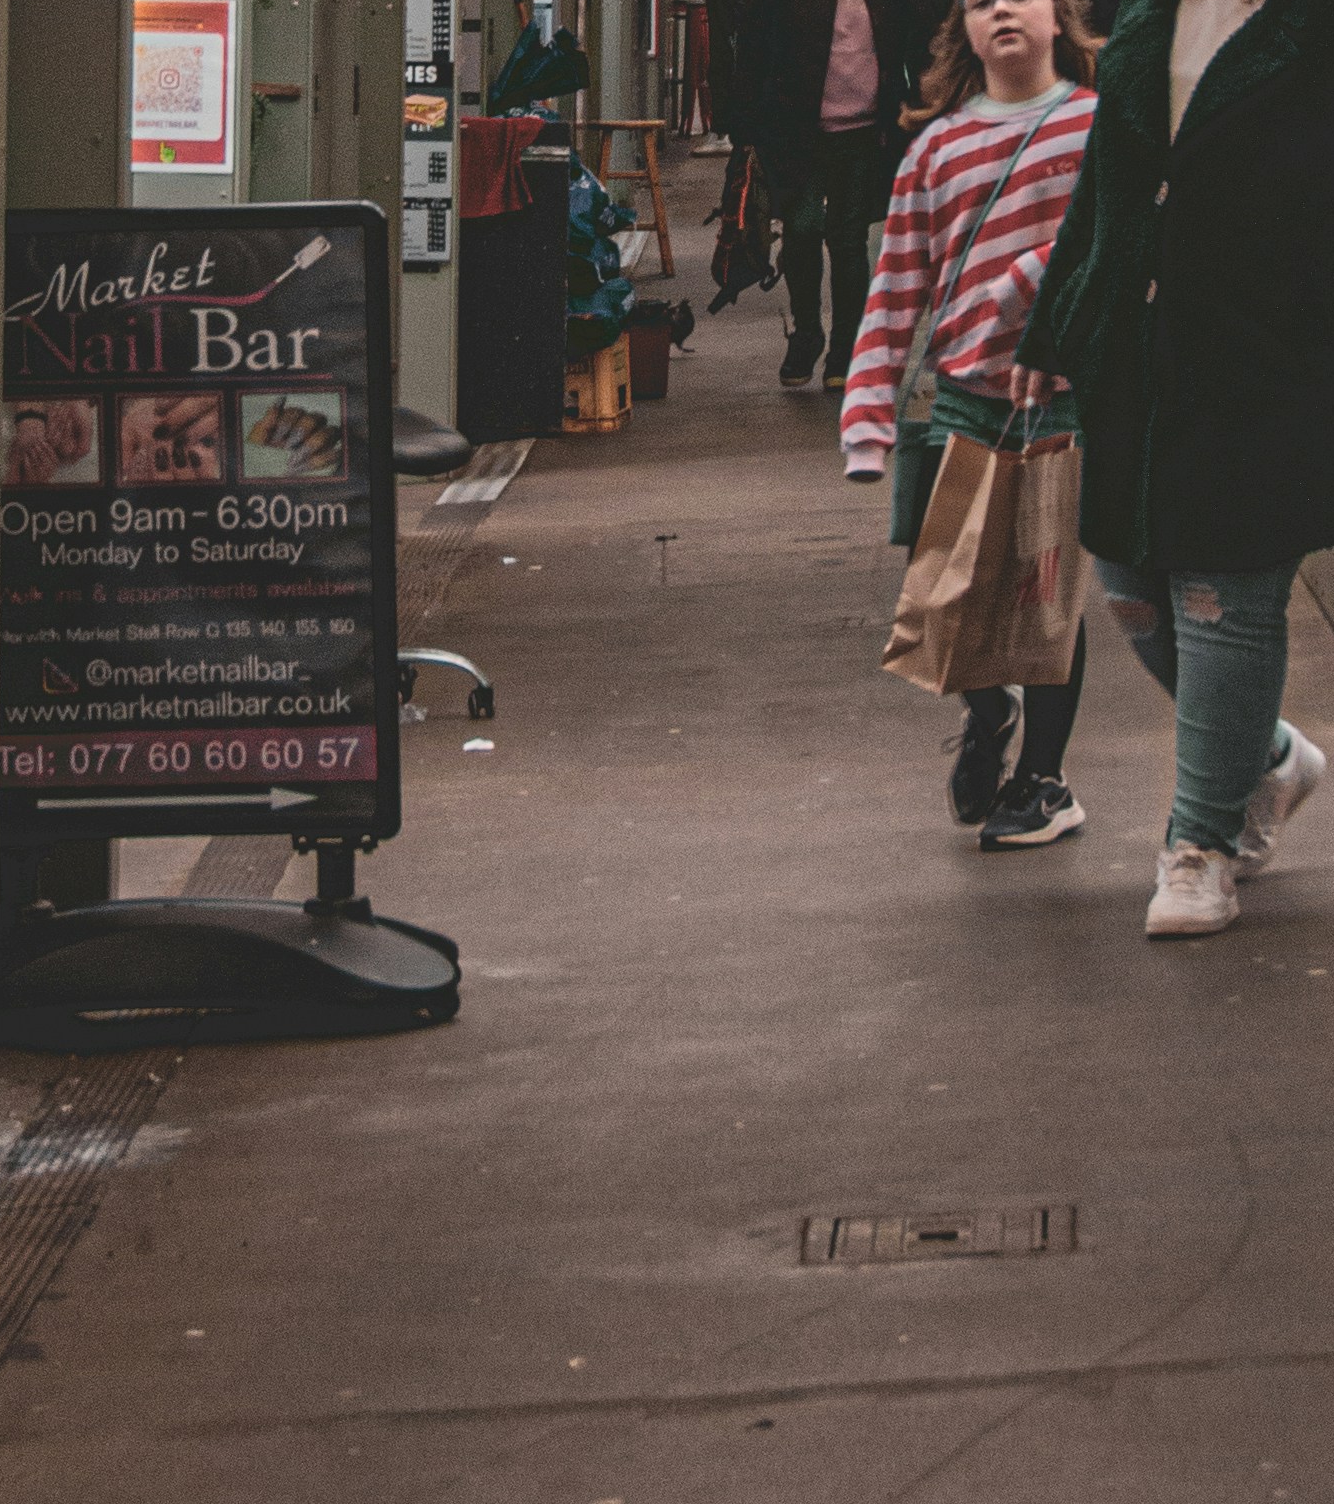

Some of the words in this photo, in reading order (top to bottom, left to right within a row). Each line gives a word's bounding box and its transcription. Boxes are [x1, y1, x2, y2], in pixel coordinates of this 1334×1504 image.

[4, 242, 217, 321] Market
[18, 305, 165, 375] Nail
[189, 307, 319, 374] Bar
[0, 502, 97, 541] Open
[110, 498, 186, 533] 9am
[217, 494, 349, 535] 6.30pm
[41, 542, 143, 569] Monday
[155, 542, 179, 563] to
[191, 537, 305, 566] Saturday
[86, 654, 311, 687] @marketnailbar_
[5, 689, 351, 724] www.marketnailbar.co.uk
[69, 742, 134, 775] 077
[148, 741, 191, 773] 60
[204, 741, 247, 772] 60
[261, 739, 304, 770] 60
[317, 737, 359, 769] 57
